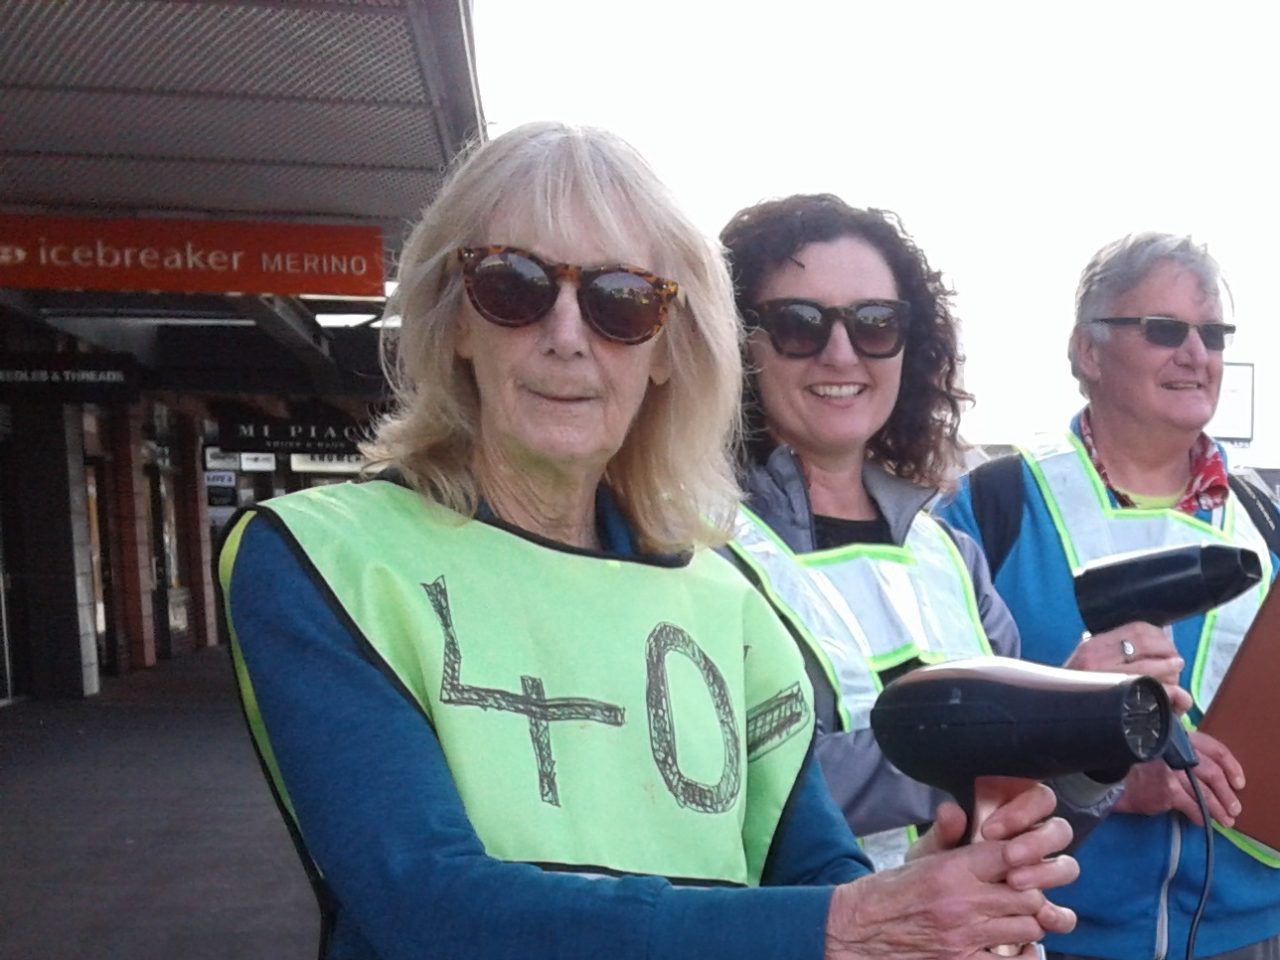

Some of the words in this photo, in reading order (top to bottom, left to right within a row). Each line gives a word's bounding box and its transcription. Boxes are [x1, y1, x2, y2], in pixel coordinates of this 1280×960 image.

[39, 238, 244, 272] icebreaker
[261, 252, 367, 276] MERINO
[239, 424, 270, 438] MI
[290, 424, 373, 440] PIAC
